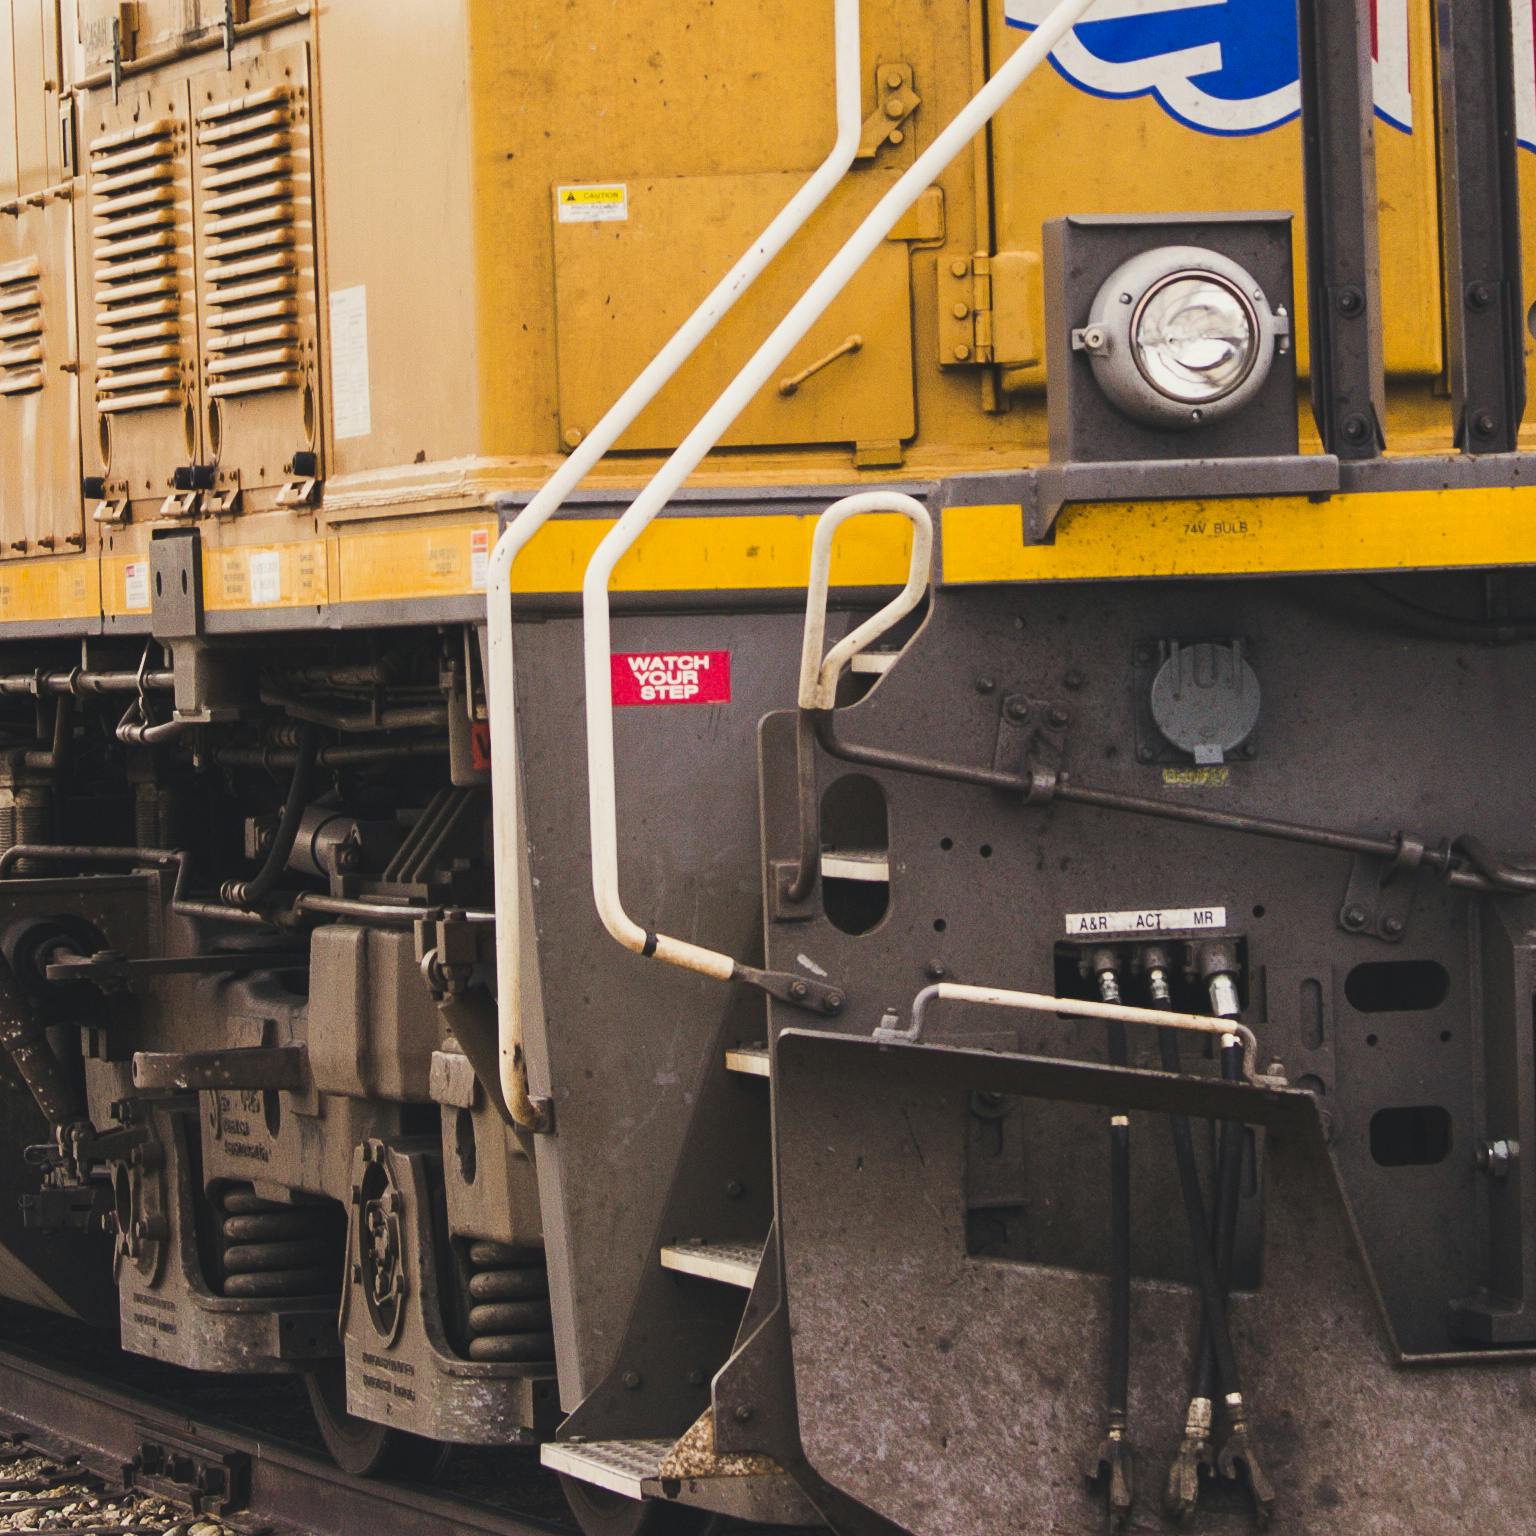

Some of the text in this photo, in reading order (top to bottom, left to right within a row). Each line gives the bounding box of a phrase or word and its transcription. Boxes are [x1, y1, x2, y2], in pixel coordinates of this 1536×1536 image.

[583, 191, 619, 200] CAUTION
[1183, 521, 1248, 535] 74V BULB
[627, 655, 710, 671] WATCH
[632, 670, 699, 686] YOUR
[640, 684, 700, 701] STEP
[1079, 910, 1214, 931] A&R ACT MR
